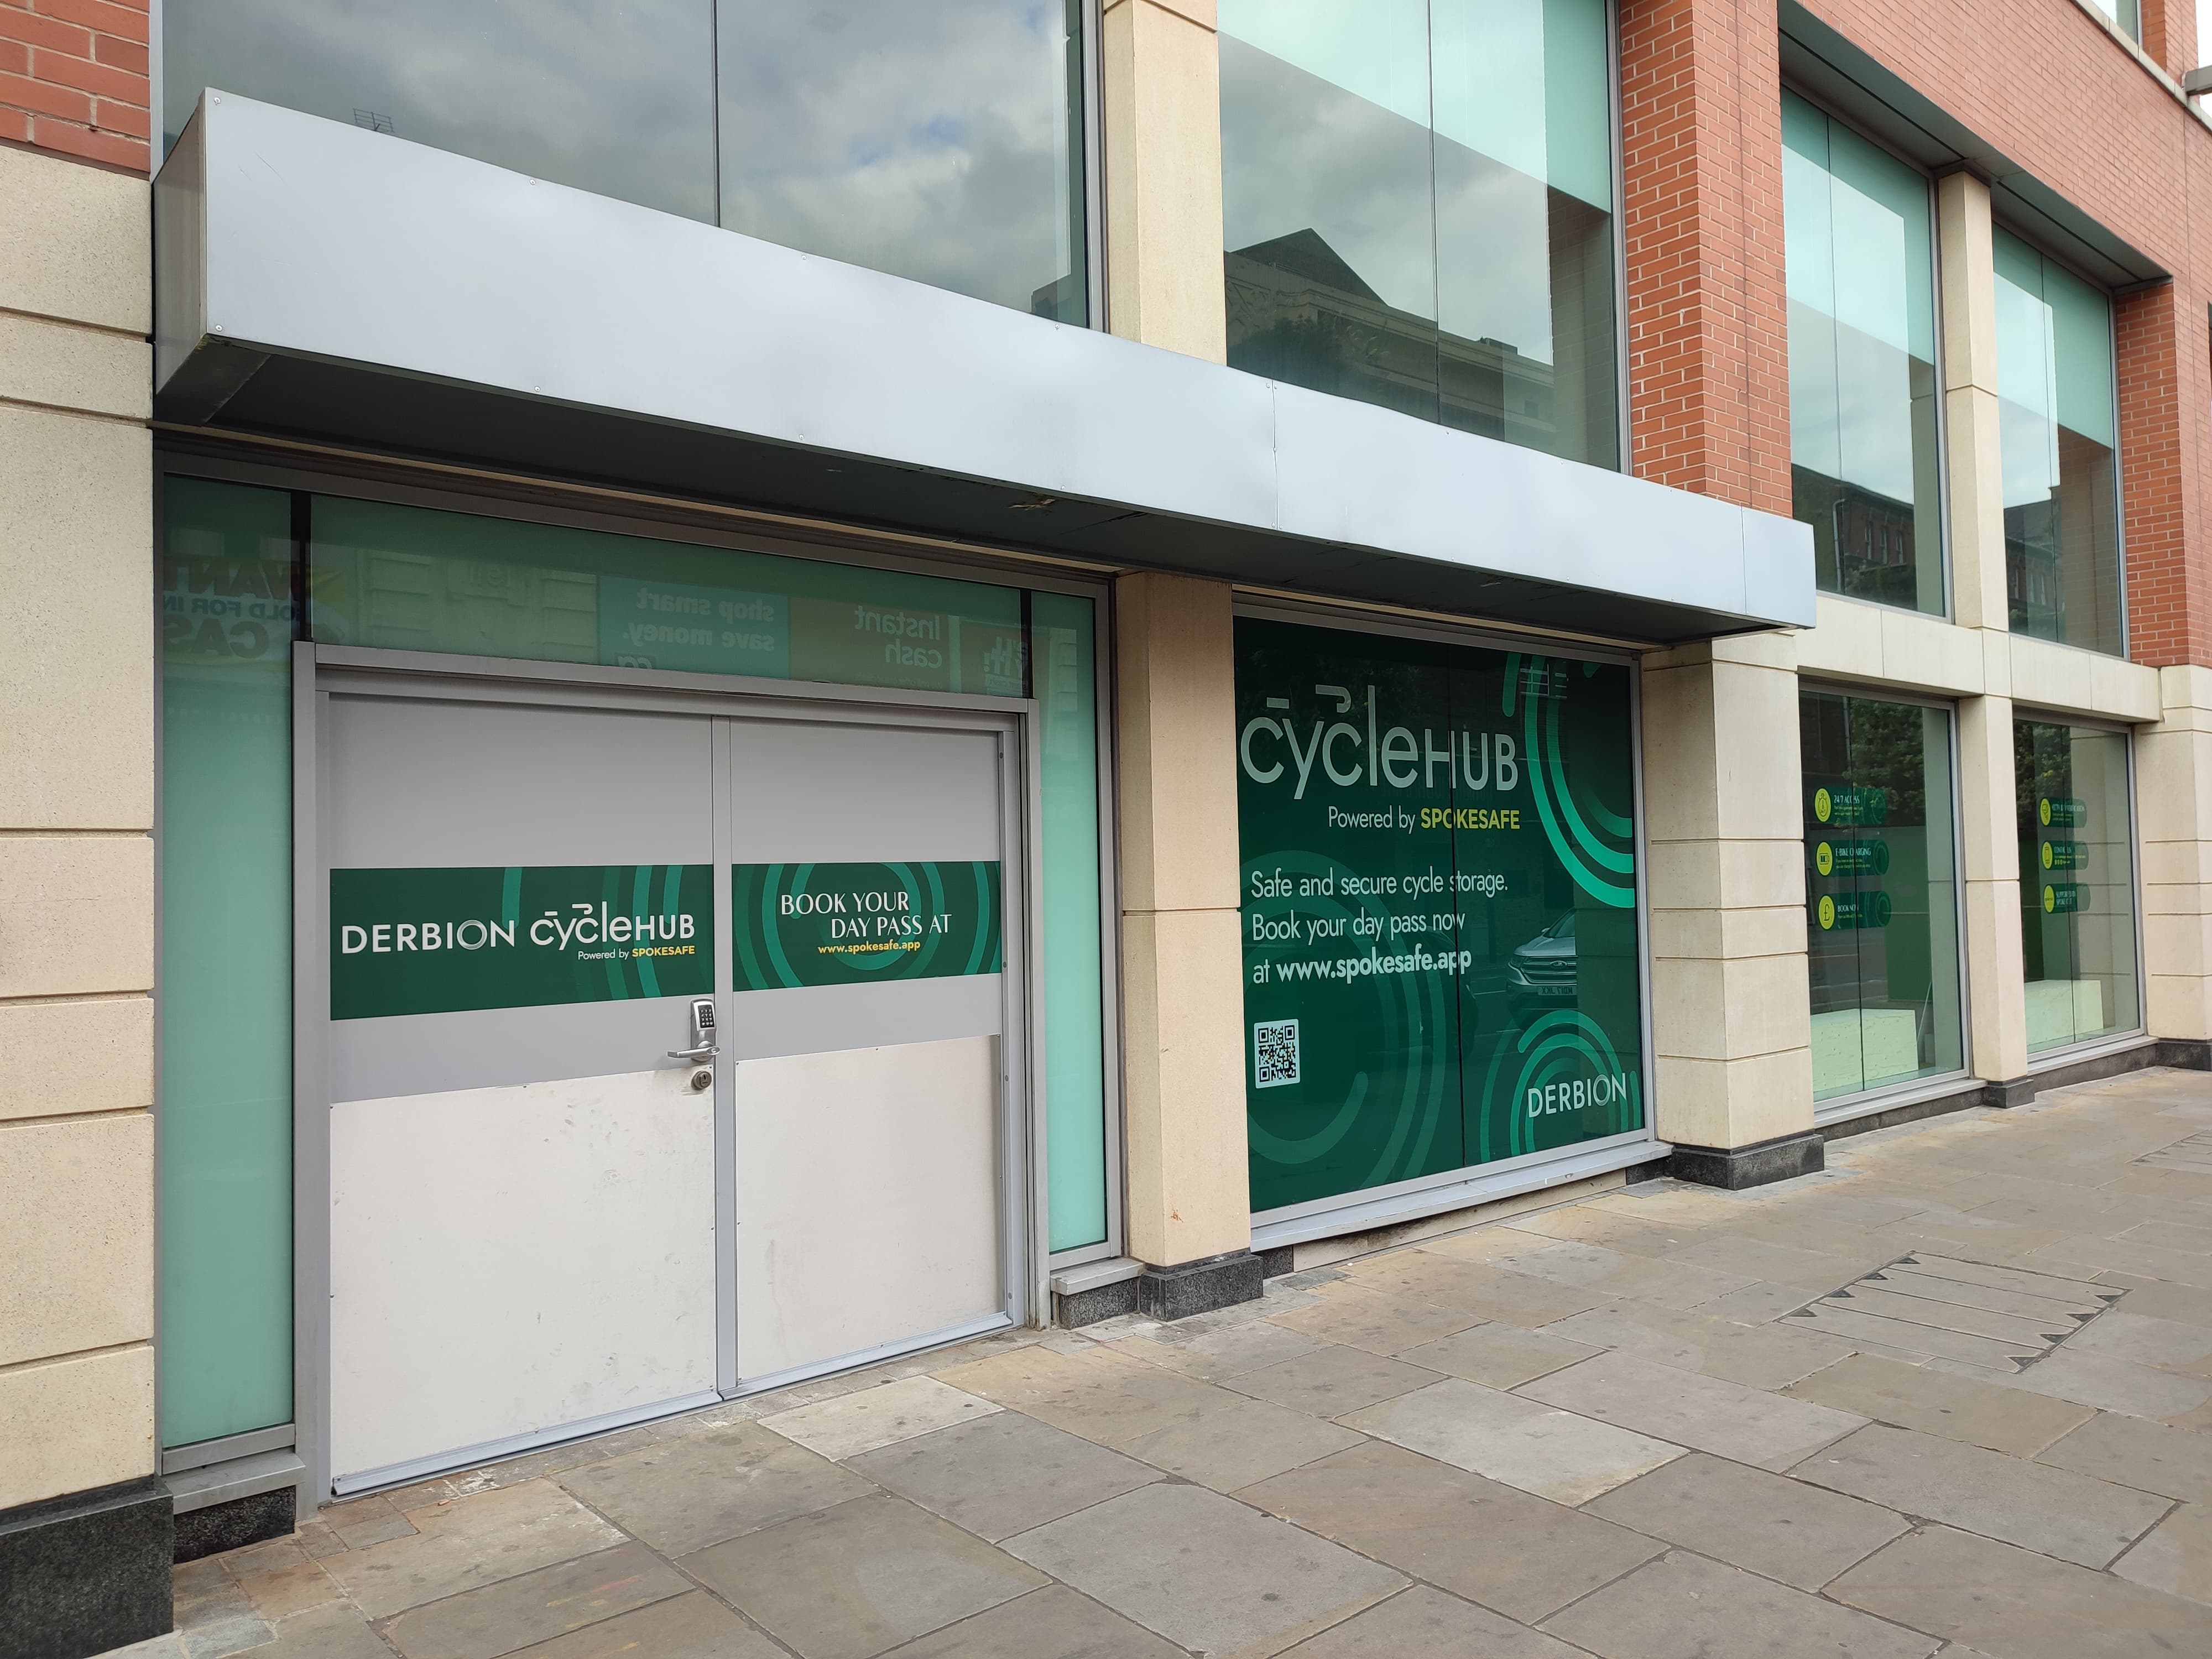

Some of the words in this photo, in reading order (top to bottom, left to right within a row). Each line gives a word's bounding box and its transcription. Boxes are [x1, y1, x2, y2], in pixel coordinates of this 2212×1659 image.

[1844, 795, 1860, 804] ACCSS
[1328, 805, 1393, 828] Powered
[1399, 805, 1416, 834] by
[1420, 807, 1520, 830] SPOKESAFE
[1251, 867, 1292, 898] Safe
[1299, 867, 1334, 896] and
[1341, 875, 1397, 895] secure
[1402, 865, 1444, 900] cycle
[1449, 870, 1509, 898] storage.
[781, 893, 847, 915] BOOK
[852, 891, 909, 912] YOUR
[341, 919, 515, 954] DERBION
[831, 917, 870, 938] DAY
[877, 915, 922, 936] PASS
[929, 914, 952, 934] AT
[1252, 910, 1301, 941] Book
[1306, 916, 1347, 946] your
[1353, 906, 1384, 942] day
[1390, 915, 1427, 941] pass
[1433, 912, 1465, 931] now
[578, 949, 615, 960] Powered
[618, 948, 629, 960] by
[632, 946, 695, 958] SPOKESAFE
[817, 938, 921, 954] www.spokesafe.app
[1253, 959, 1270, 984] at
[1276, 943, 1472, 984] www.spokesafe.app
[1527, 1073, 1627, 1118] DERBION
